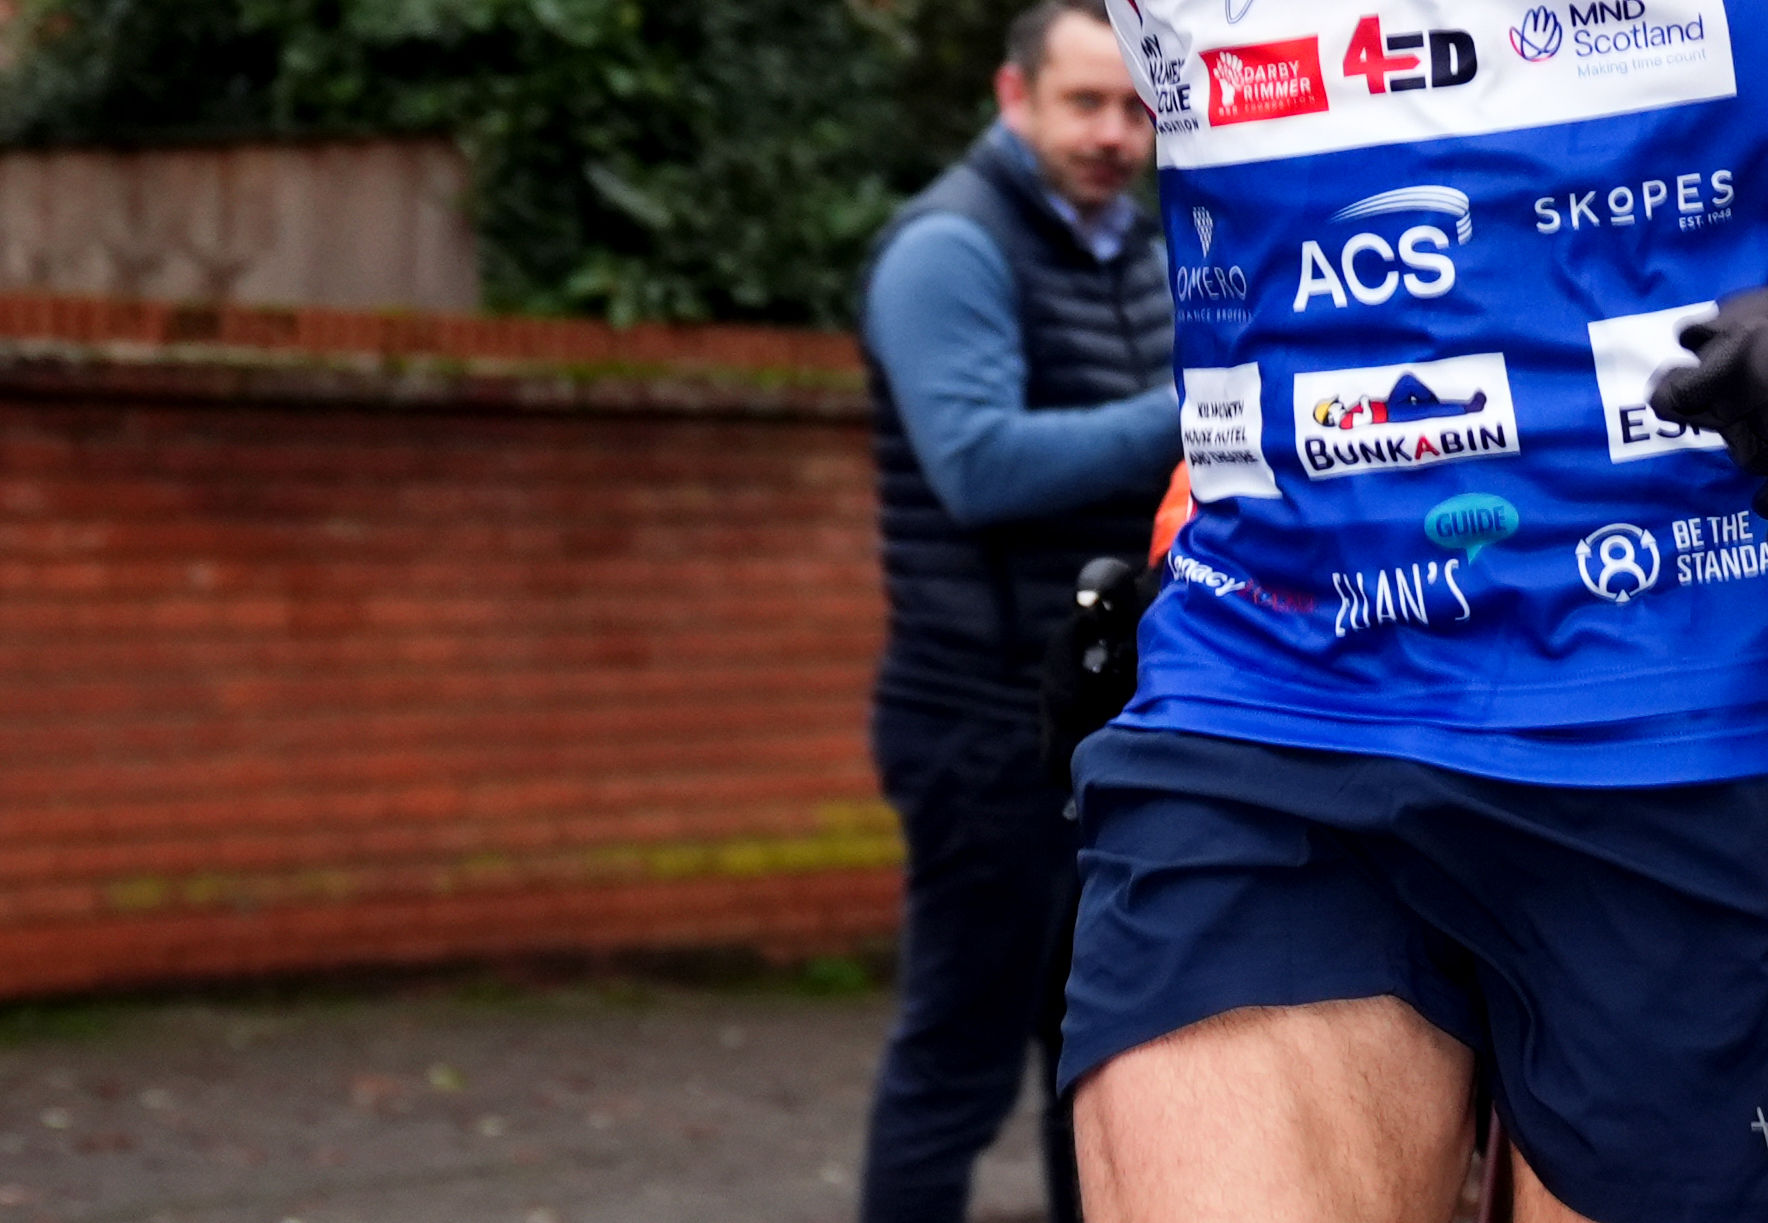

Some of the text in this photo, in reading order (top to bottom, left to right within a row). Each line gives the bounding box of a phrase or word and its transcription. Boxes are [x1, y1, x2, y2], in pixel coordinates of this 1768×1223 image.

[1343, 13, 1478, 94] 4ED
[1574, 13, 1704, 57] Scotland
[1244, 60, 1299, 83] DARBY
[1577, 49, 1706, 79] Making time count
[1244, 77, 1311, 102] RIMMER
[1534, 169, 1735, 234] SKOPES
[1292, 224, 1457, 314] ACS
[1305, 424, 1507, 471] BUNKABIN
[1436, 506, 1507, 538] GUIDE
[1672, 511, 1753, 551] BE THE
